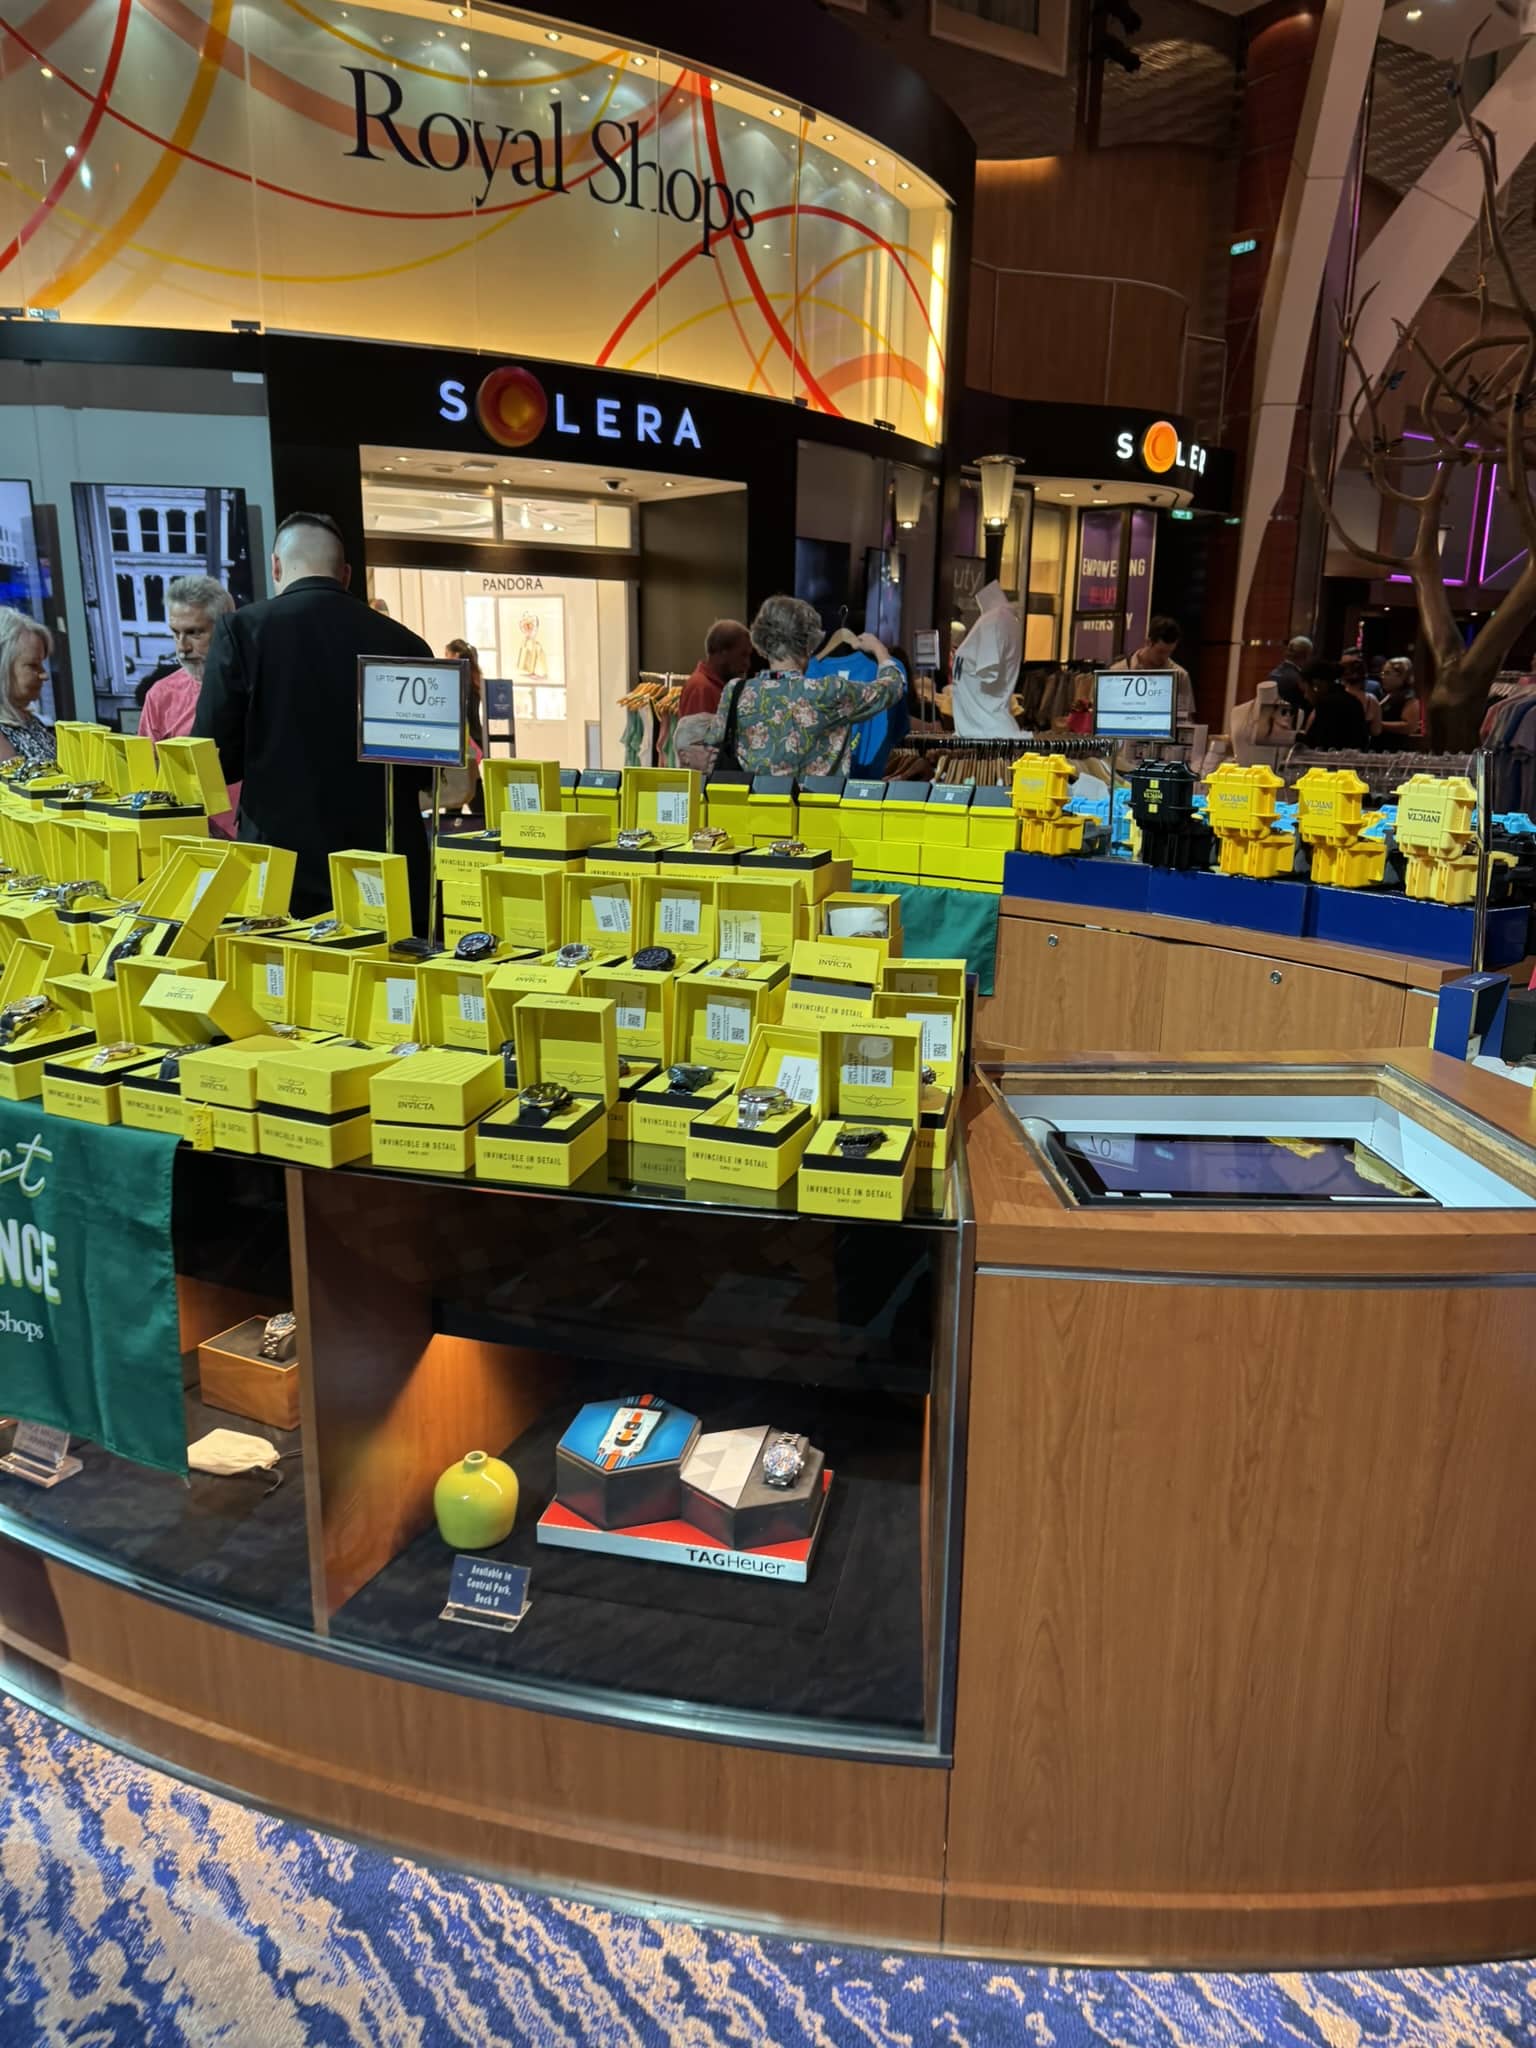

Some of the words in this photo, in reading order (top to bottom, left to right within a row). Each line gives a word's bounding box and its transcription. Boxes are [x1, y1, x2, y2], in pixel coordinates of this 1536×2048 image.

[340, 65, 570, 208] Royal
[588, 120, 755, 258] Shops
[439, 366, 701, 448] SOLERA
[483, 577, 544, 591] PANDORA
[427, 696, 447, 706] OFF
[1407, 812, 1441, 824] INVICTA
[519, 830, 546, 839] INVICTA
[817, 958, 853, 969] INVICTA
[791, 1002, 829, 1014] INVINCIBLE
[840, 1009, 863, 1018] DETAIL
[398, 1100, 435, 1111] INVICTA
[640, 1117, 677, 1128] INVINCIBLE
[379, 1138, 420, 1149] INVINCIBLE
[432, 1142, 457, 1151] DETAIL
[483, 1151, 527, 1163] INVINCIBLE
[528, 1156, 534, 1164] IN
[537, 1156, 561, 1166] DETAIL
[692, 1151, 732, 1164] INVINCIBLE
[734, 1157, 742, 1165] IN
[744, 1158, 769, 1169] DETAIL
[806, 1184, 850, 1196] INVINCIBLE
[854, 1188, 863, 1197] IN
[865, 1189, 893, 1199] DETAIL
[685, 1548, 786, 1576] TAGHeuer
[471, 1564, 503, 1580] Available
[503, 1571, 512, 1582] in
[466, 1577, 493, 1592] Central
[475, 1593, 492, 1605] Deck
